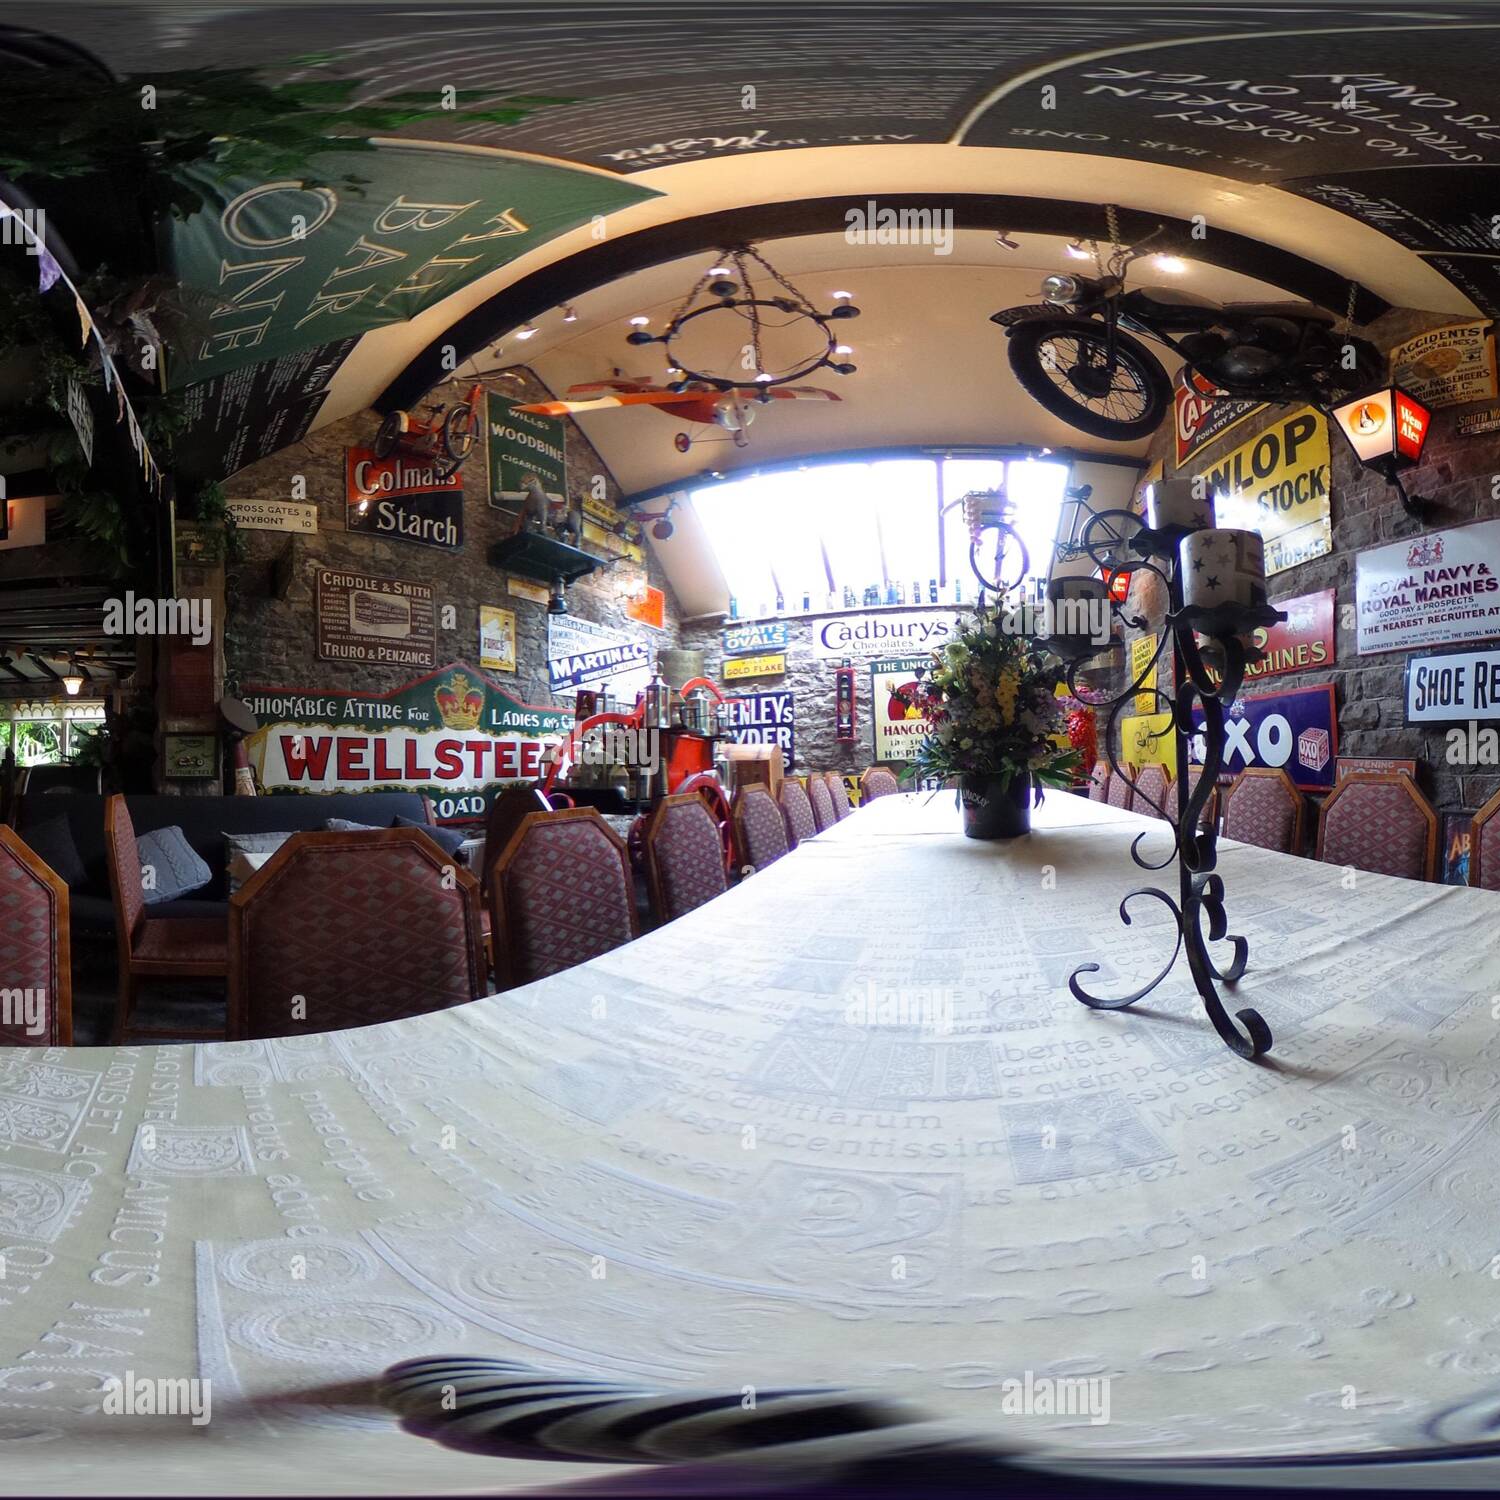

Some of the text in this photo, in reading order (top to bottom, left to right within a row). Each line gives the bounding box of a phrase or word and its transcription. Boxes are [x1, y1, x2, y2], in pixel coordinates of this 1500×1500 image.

[1081, 66, 1300, 97] OVER
[1290, 72, 1459, 110] ONLY
[1082, 83, 1419, 158] NO CHILDREN
[1154, 110, 1317, 144] SORRY
[199, 180, 339, 361] ONE
[294, 195, 482, 330] BAR
[375, 207, 530, 308] ALL
[1398, 327, 1480, 356] ACCIDENTS
[1430, 368, 1491, 387] PASSENGERS
[1195, 416, 1228, 443] POULTRY
[1401, 405, 1423, 431] Wem
[1458, 411, 1488, 428] SOUTH
[490, 421, 566, 464] WOODBINE
[1400, 422, 1420, 444] Ales
[501, 453, 558, 483] CIGARETTES
[1205, 414, 1317, 498] NLOP
[354, 459, 456, 496] Colmas
[1257, 464, 1327, 514] STOCK
[230, 504, 264, 514] CROSS
[267, 505, 300, 517] GATES
[301, 520, 312, 528] 10
[375, 501, 458, 547] Starch
[323, 571, 431, 600] CRIDDLE & SMITH
[1366, 562, 1492, 597] ROYAL NAVY &
[1361, 577, 1499, 615] ROYAL MARINES
[1379, 607, 1400, 619] GOOD
[1401, 604, 1416, 615] PAY
[1423, 596, 1475, 610] PROSPECTS
[820, 620, 949, 650] Cadbury's
[1363, 625, 1380, 636] THE
[1382, 617, 1424, 633] NEAREST
[1427, 609, 1486, 625] RECRUITER
[1488, 606, 1500, 616] AT
[323, 642, 432, 666] TRURO & PENZANCE
[726, 633, 785, 650] OVALS
[852, 638, 915, 651] Chocolates
[551, 645, 623, 680] MARTIN
[726, 663, 784, 677] GOLD FLAKE
[876, 662, 897, 673] THE
[1415, 665, 1466, 712] SHOE
[343, 699, 403, 721] ATTIRE
[491, 709, 540, 728] LADIES
[729, 728, 792, 749] YDER
[1299, 738, 1317, 759] OXO
[279, 735, 560, 782] WELLSTEE
[1300, 754, 1319, 768] CUBE
[1353, 760, 1395, 769] EVENING
